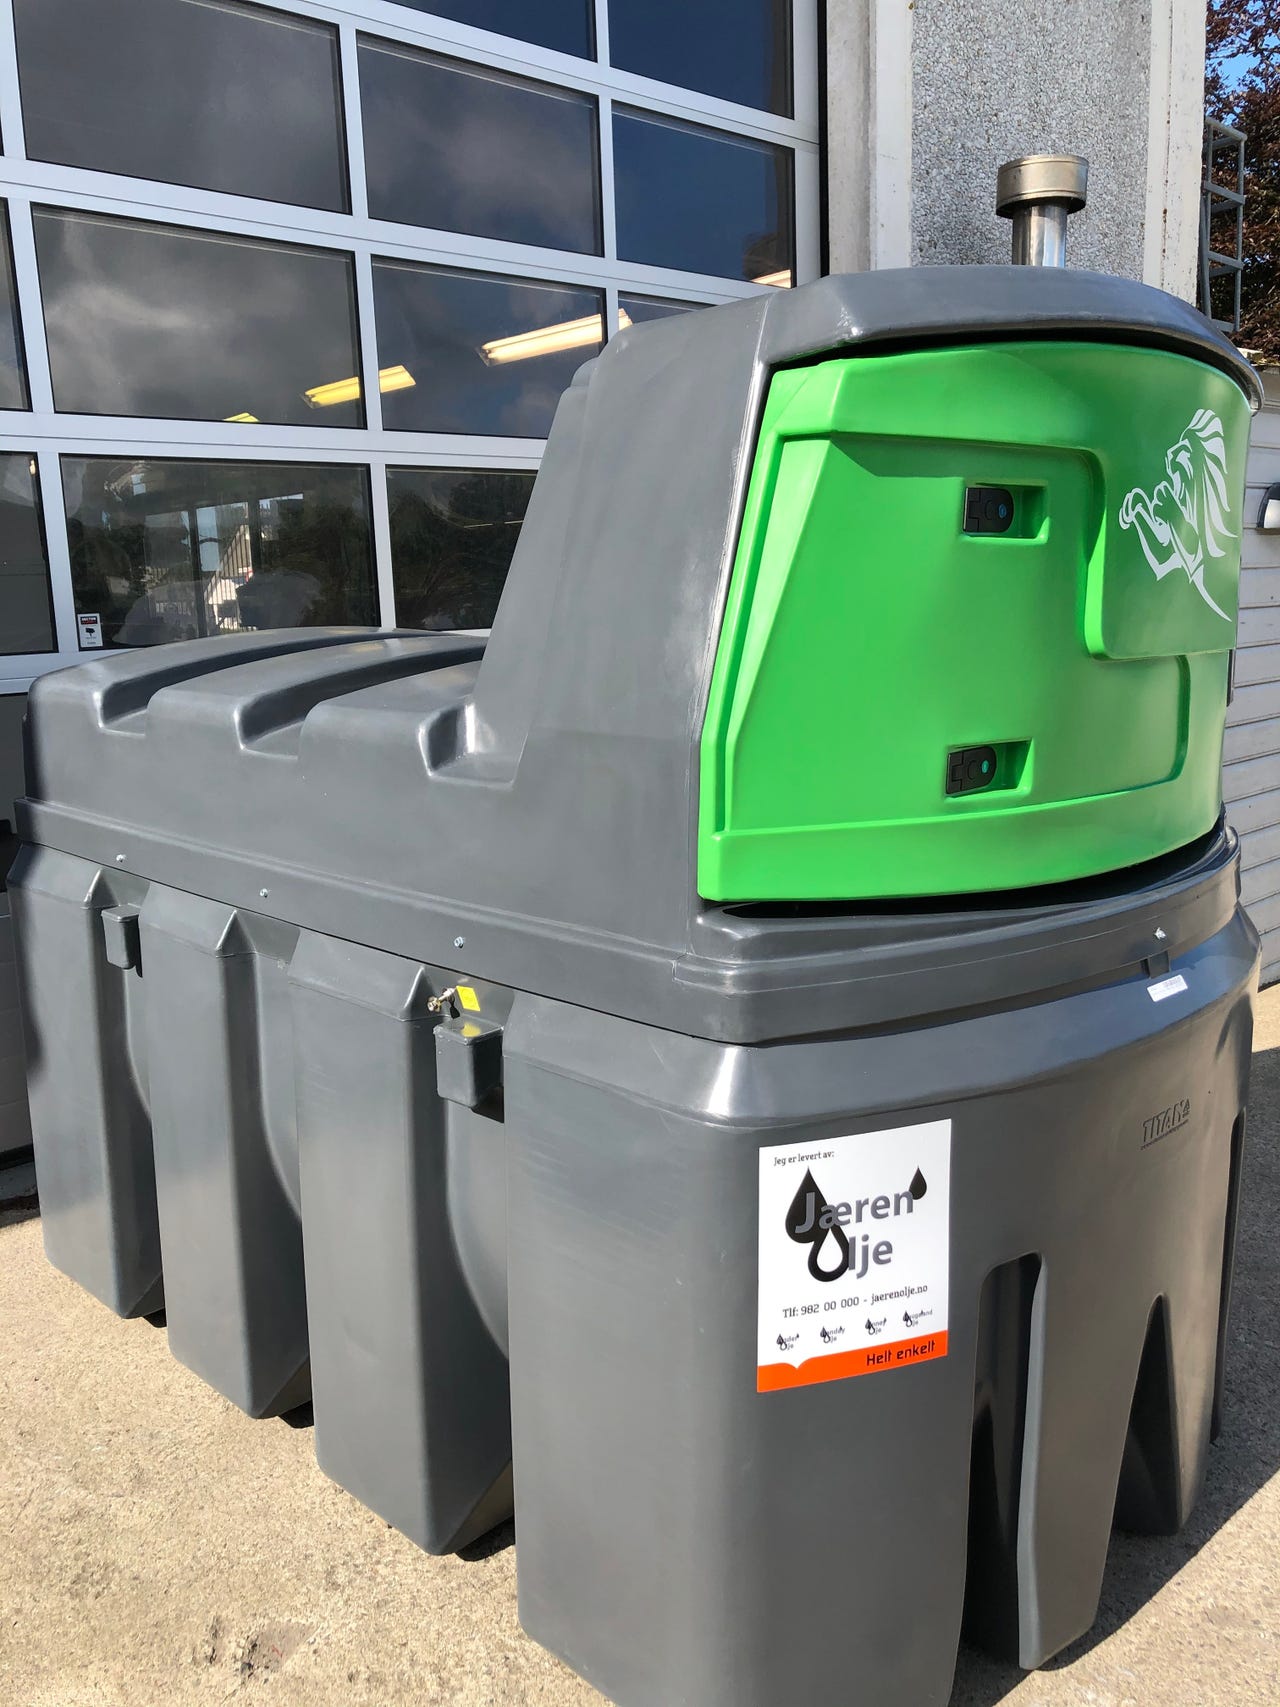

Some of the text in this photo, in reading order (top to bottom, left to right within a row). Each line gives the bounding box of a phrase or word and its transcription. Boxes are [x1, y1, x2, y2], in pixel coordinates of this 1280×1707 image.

[1142, 1100, 1184, 1142] TITAN
[773, 1156, 787, 1167] Jeg
[798, 1151, 821, 1162] levert
[822, 1151, 835, 1159] av:
[795, 1189, 914, 1234] Jæren
[782, 1307, 799, 1319] Tlf:
[800, 1303, 820, 1316] 982
[823, 1300, 837, 1312] 00
[840, 1296, 860, 1309] 000
[871, 1284, 928, 1306] jaerenolje.no
[866, 1340, 936, 1367] Helt enkelt
